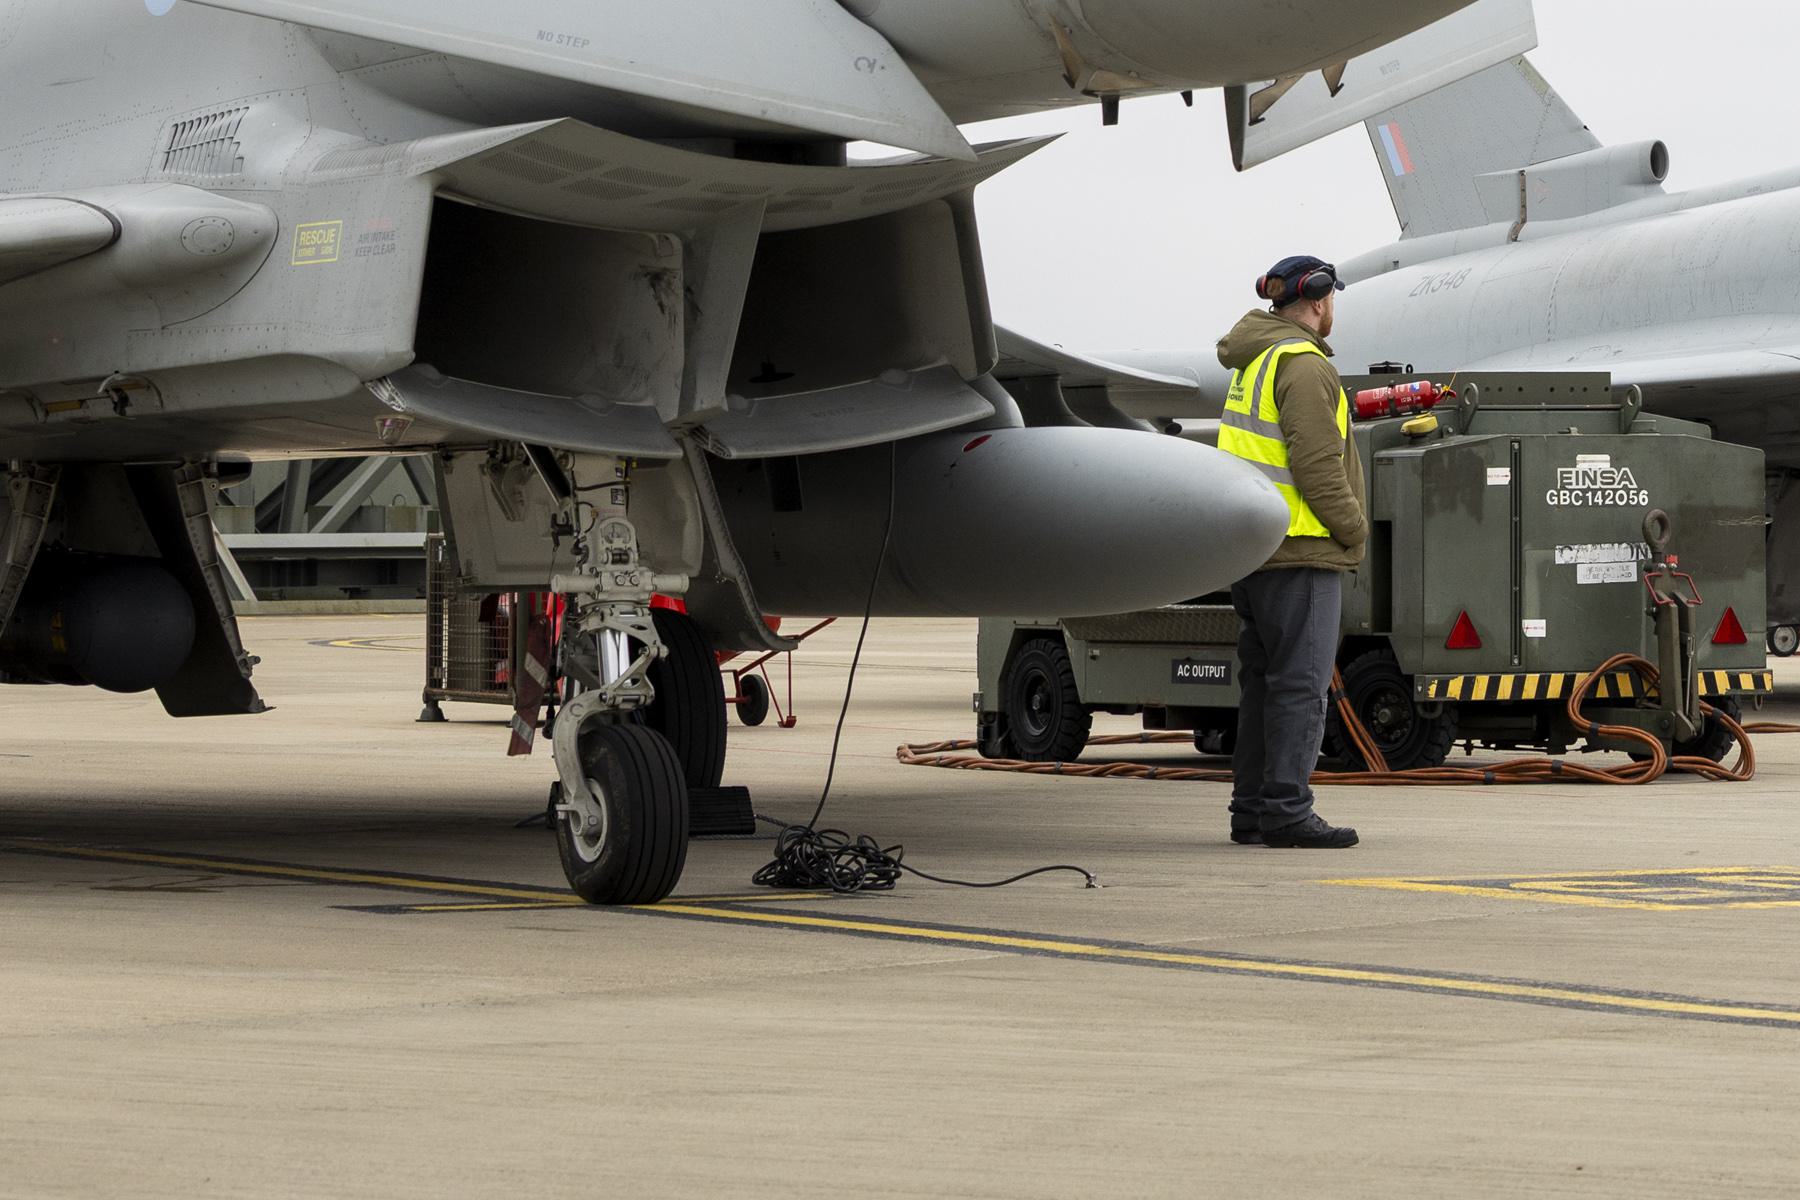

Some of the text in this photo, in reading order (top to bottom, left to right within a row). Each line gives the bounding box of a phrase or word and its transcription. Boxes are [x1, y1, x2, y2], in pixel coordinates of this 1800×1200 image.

[536, 29, 591, 49] NO STEP
[299, 227, 336, 246] RESCUE
[359, 231, 371, 243] AIR
[354, 242, 397, 258] KEEP CLEAR
[1408, 267, 1472, 298] ZK348
[1557, 467, 1638, 489] EINSA
[1177, 664, 1226, 678] AC OUTPUT
